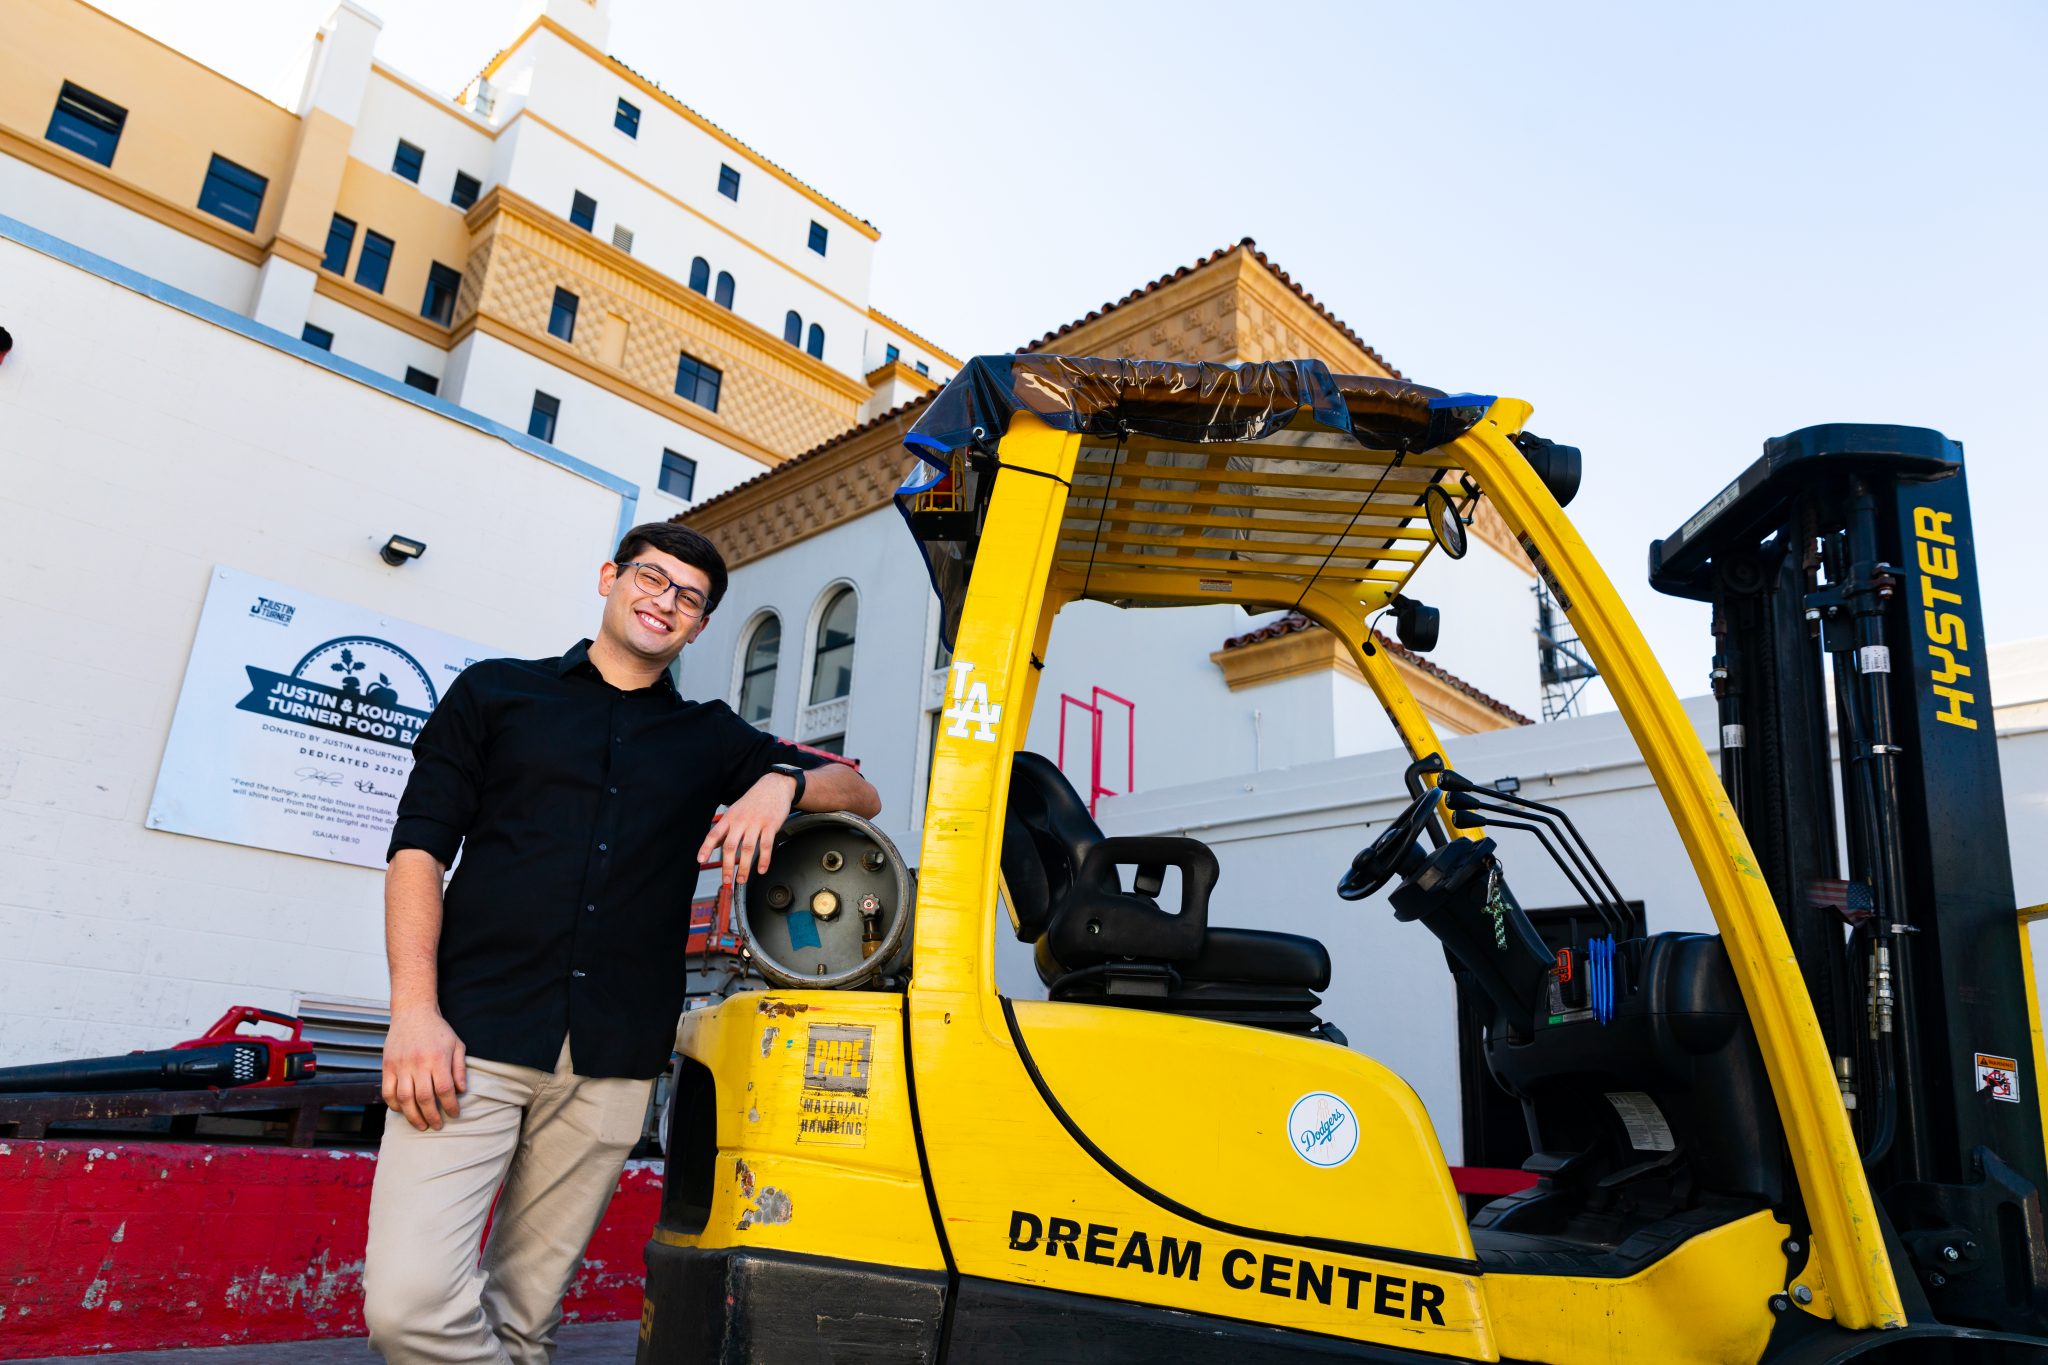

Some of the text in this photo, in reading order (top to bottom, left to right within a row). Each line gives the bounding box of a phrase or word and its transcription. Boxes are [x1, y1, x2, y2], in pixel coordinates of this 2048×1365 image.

[1913, 506, 1979, 731] HYSTER
[271, 682, 338, 710] JUSTIN
[340, 698, 353, 713] &
[944, 661, 1002, 742] LA
[267, 696, 342, 727] TURNER
[345, 716, 397, 739] FOOD
[262, 723, 307, 739] DONATED
[309, 734, 321, 743] BY
[323, 737, 353, 751] JUSTIN
[363, 747, 410, 764] KOURTNEY
[300, 747, 404, 776] DEDICATED 2020
[248, 791, 270, 800] shine
[271, 795, 284, 803] out
[286, 798, 304, 807] from
[306, 802, 319, 810] the
[371, 815, 384, 823] the
[256, 783, 269, 791] the
[302, 793, 317, 801] and
[317, 795, 334, 804] help
[335, 798, 356, 808] those
[284, 807, 299, 815] you
[300, 810, 314, 818] will
[315, 812, 325, 820] be
[336, 817, 359, 826] bright
[312, 830, 339, 840] ISAIAH
[803, 1098, 864, 1115] MATERIAL
[801, 1119, 862, 1135] HANDLING
[1301, 1108, 1345, 1152] Dodgers
[1008, 1209, 1446, 1326] DREAM CENTER
